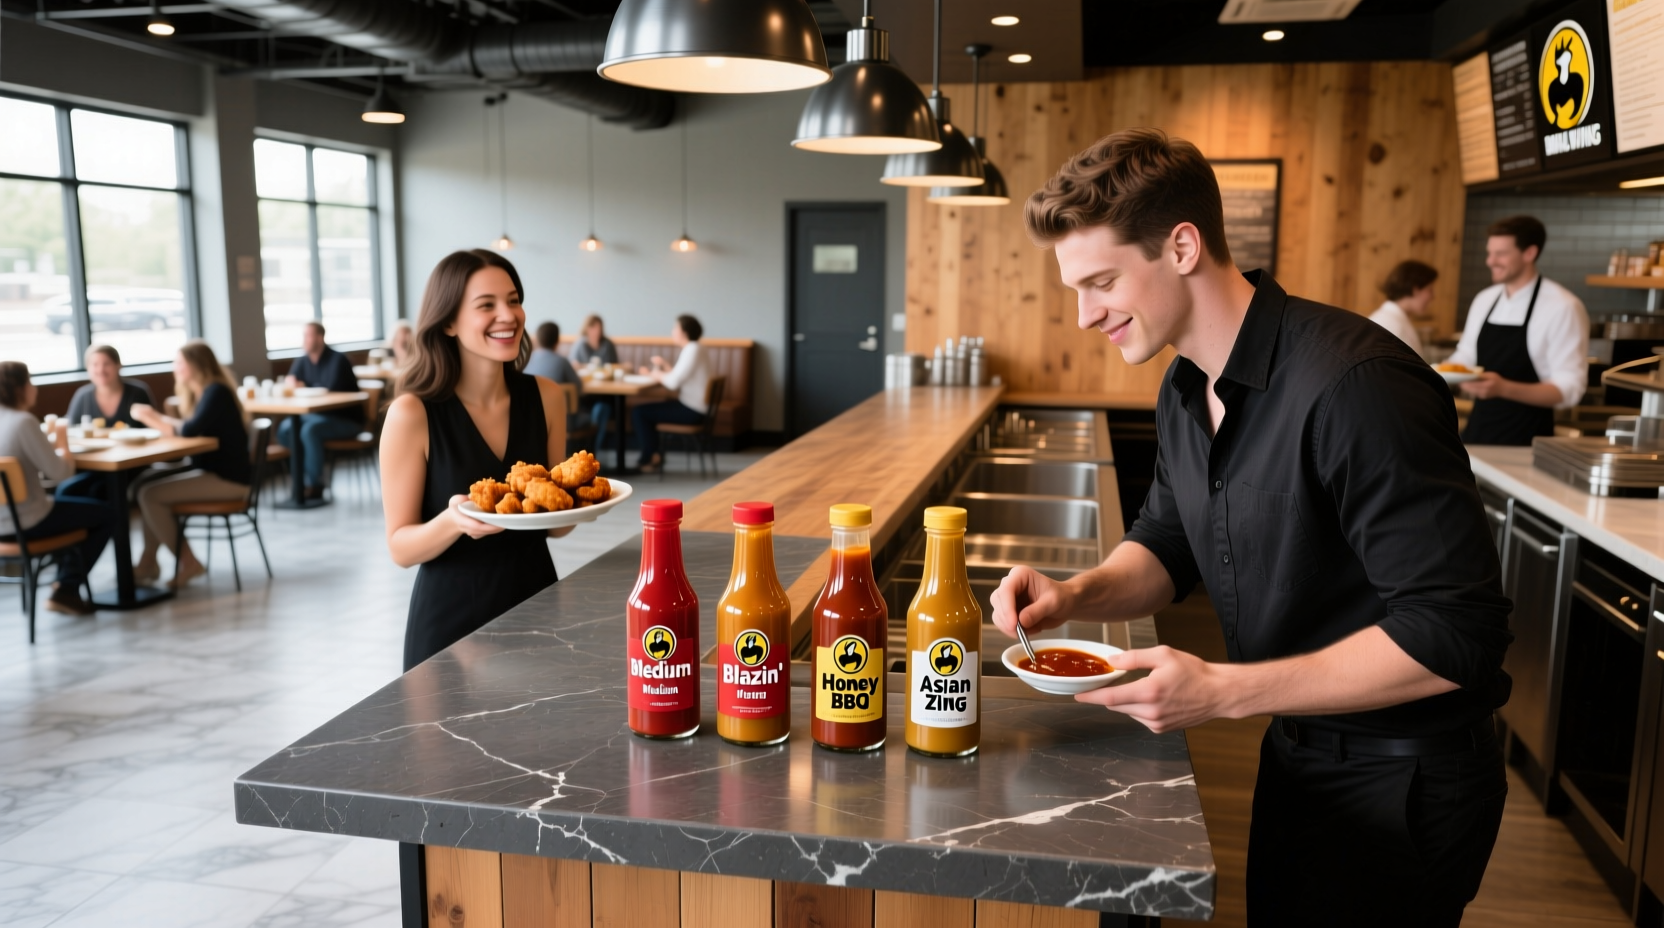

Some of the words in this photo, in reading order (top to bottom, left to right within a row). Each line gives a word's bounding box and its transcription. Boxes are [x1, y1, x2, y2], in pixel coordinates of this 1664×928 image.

[723, 663, 783, 685] Blazin'
[822, 672, 879, 695] Honey
[919, 675, 971, 694] Asian
